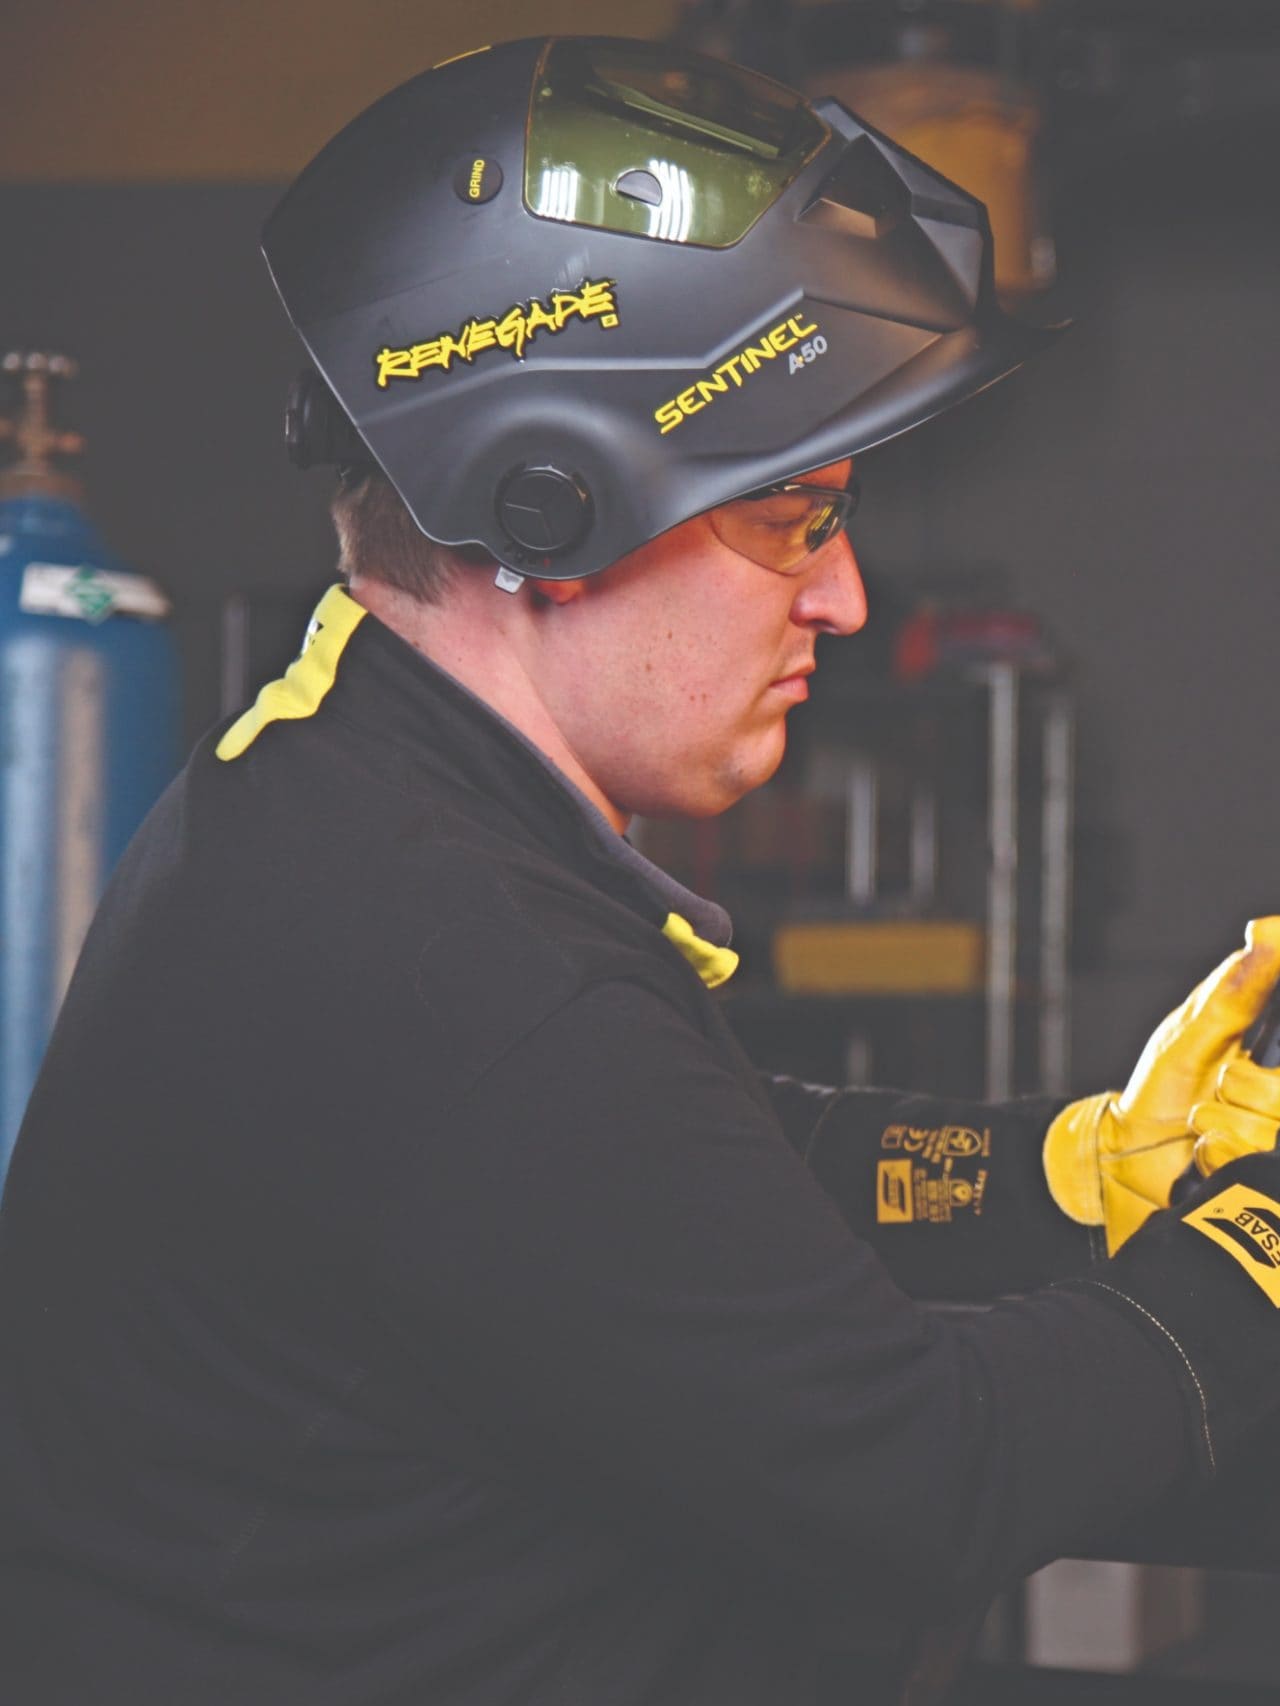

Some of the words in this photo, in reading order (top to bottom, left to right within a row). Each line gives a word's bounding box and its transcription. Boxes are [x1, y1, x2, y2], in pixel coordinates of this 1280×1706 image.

[469, 159, 485, 198] GRIND
[376, 281, 615, 387] RENEGADE
[654, 318, 818, 434] SENTINEL
